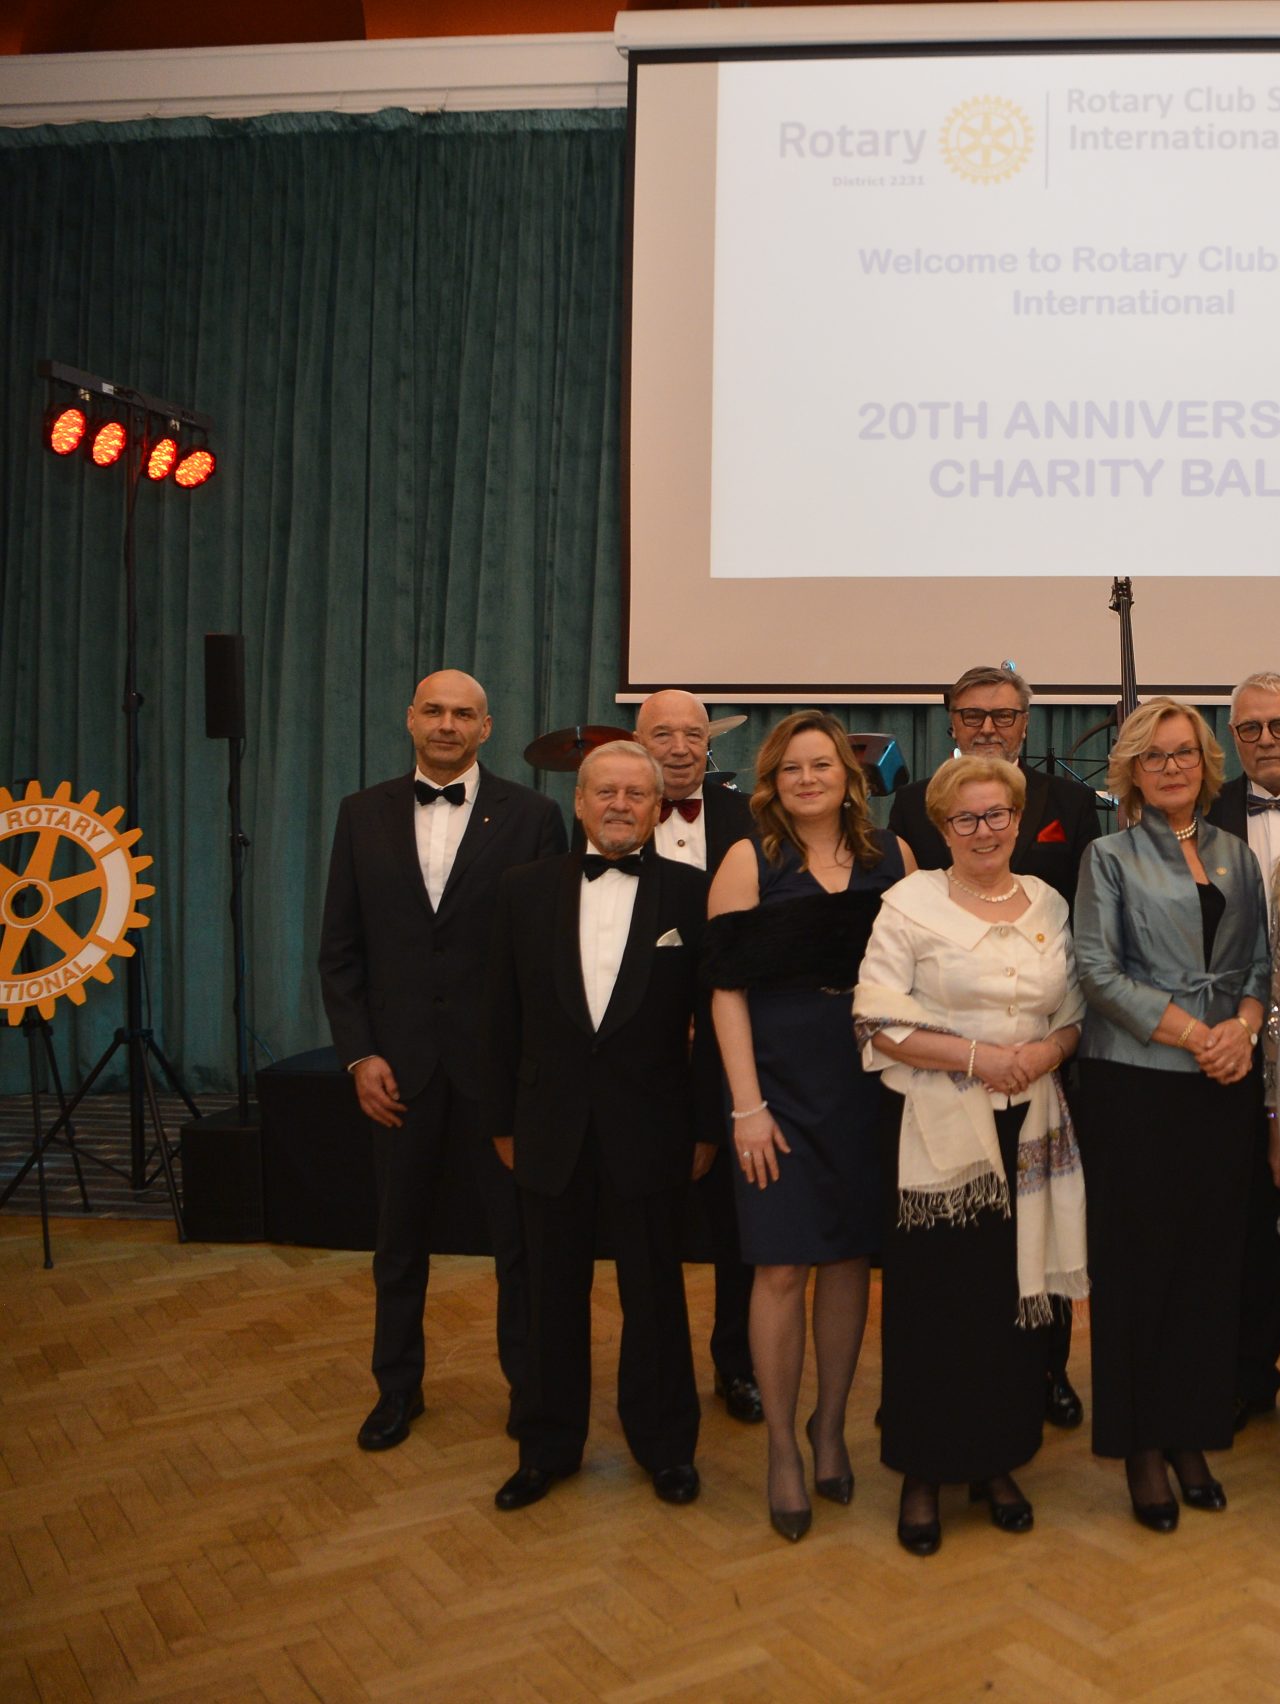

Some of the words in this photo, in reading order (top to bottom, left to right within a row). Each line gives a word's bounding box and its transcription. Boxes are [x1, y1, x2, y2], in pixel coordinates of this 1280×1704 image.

[1068, 88, 1174, 118] Rotary
[1185, 87, 1255, 112] Club
[779, 121, 927, 164] Rotary
[832, 175, 885, 187] District
[860, 249, 1017, 274] Welcome
[1028, 248, 1062, 273] to
[1073, 247, 1187, 278] Rotary
[1199, 247, 1278, 273] Club
[1014, 290, 1234, 316] International
[859, 401, 988, 440] 20TH
[930, 459, 1165, 497] CHARITY
[6, 807, 105, 841] ROTARY
[0, 960, 93, 1001] TIONAL
